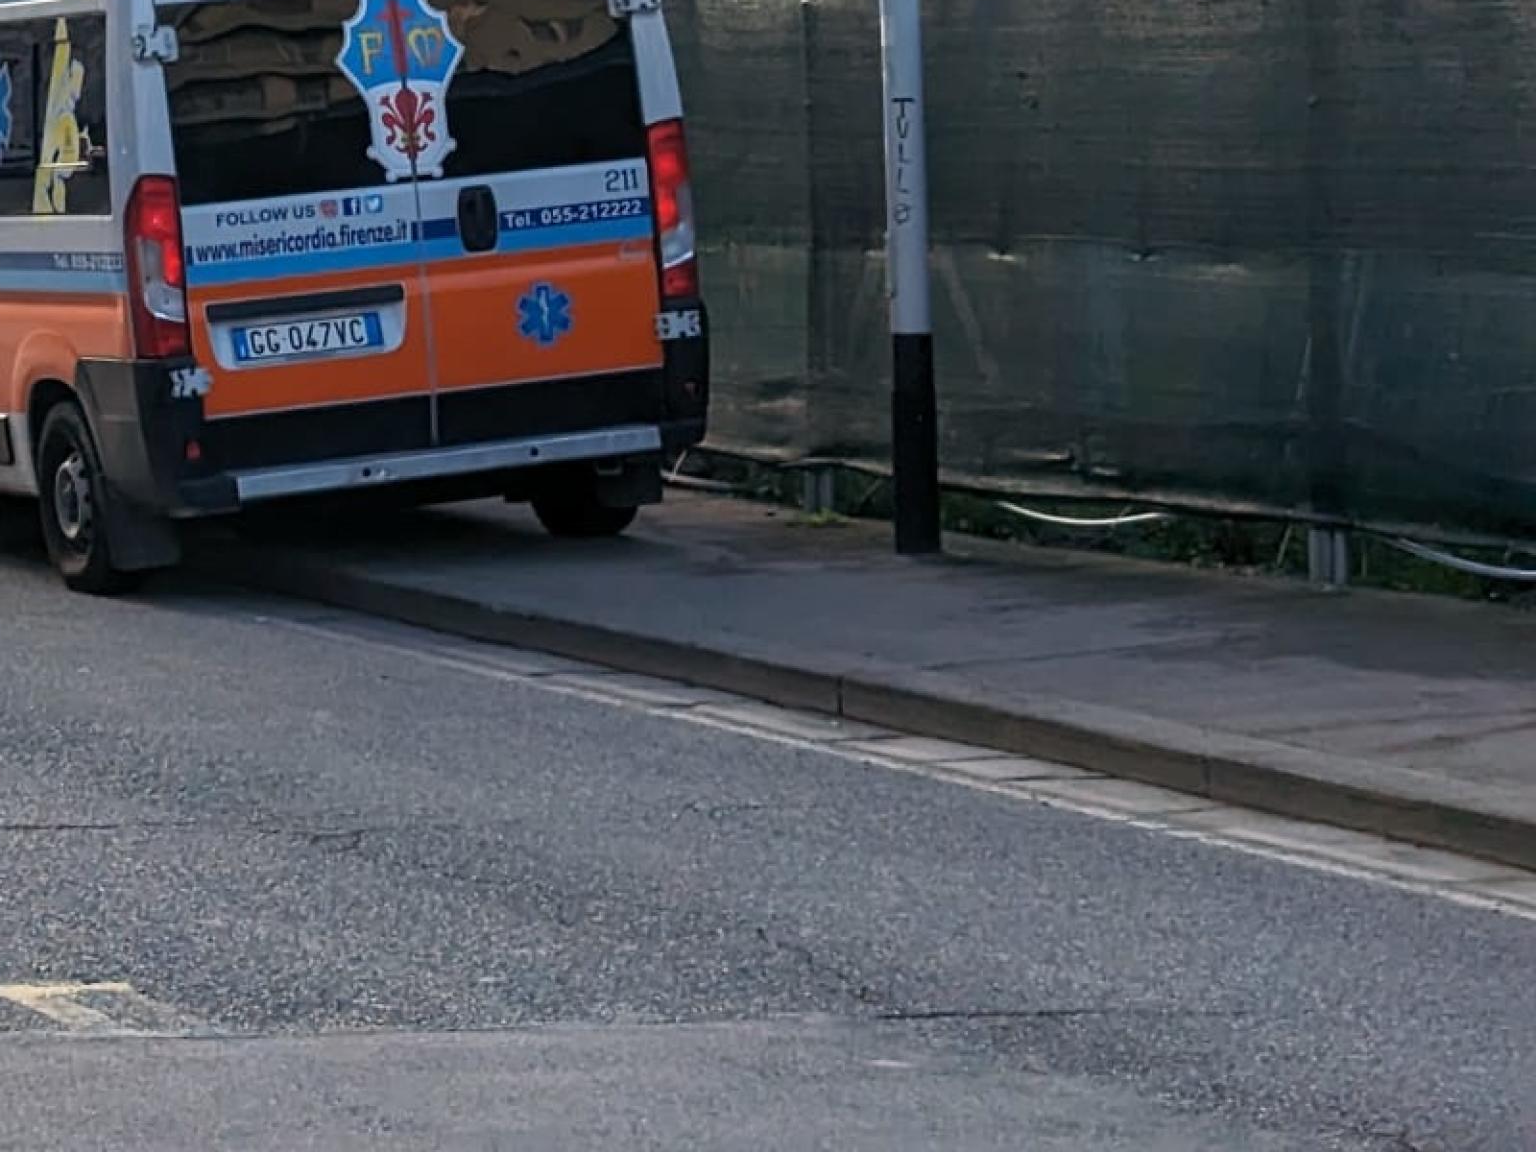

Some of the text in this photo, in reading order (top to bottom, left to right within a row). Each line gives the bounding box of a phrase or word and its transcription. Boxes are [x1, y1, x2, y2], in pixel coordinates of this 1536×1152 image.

[605, 168, 639, 193] 211
[216, 204, 315, 228] FOLLOW US
[504, 199, 642, 229] Tel. 055-212222
[196, 218, 407, 263] www.misericordia.firenze.it
[249, 318, 364, 355] GG 047VC
